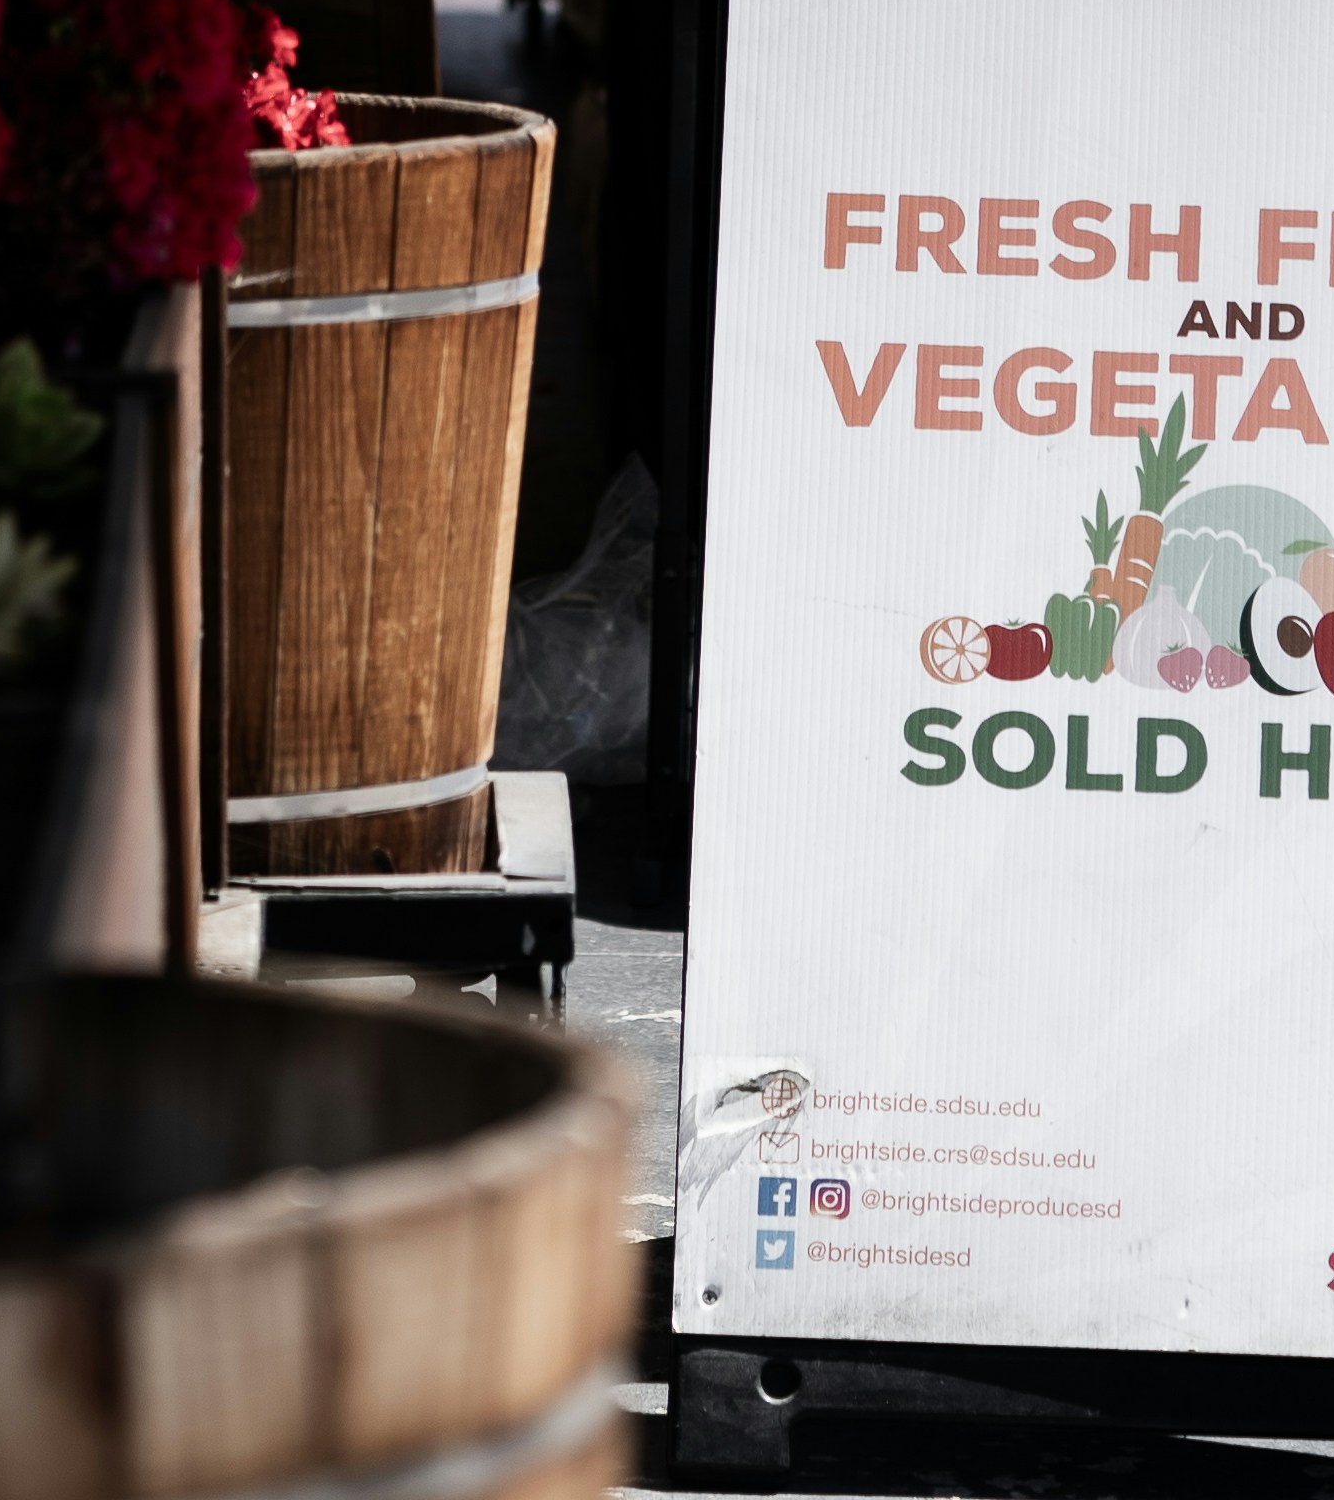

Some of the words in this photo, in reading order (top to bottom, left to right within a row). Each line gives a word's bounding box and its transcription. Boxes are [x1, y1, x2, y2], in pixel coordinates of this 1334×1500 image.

[824, 192, 1202, 283] FRESH
[1177, 300, 1305, 341] AND
[900, 707, 1208, 794] SOLD
[813, 1090, 1041, 1119] brightside.sdsu.edu
[811, 1139, 1096, 1170] brightside.crs@sdsu.edu
[861, 1190, 1122, 1219] @brightsideproducesd
[807, 1240, 971, 1269] @brightsidesd
